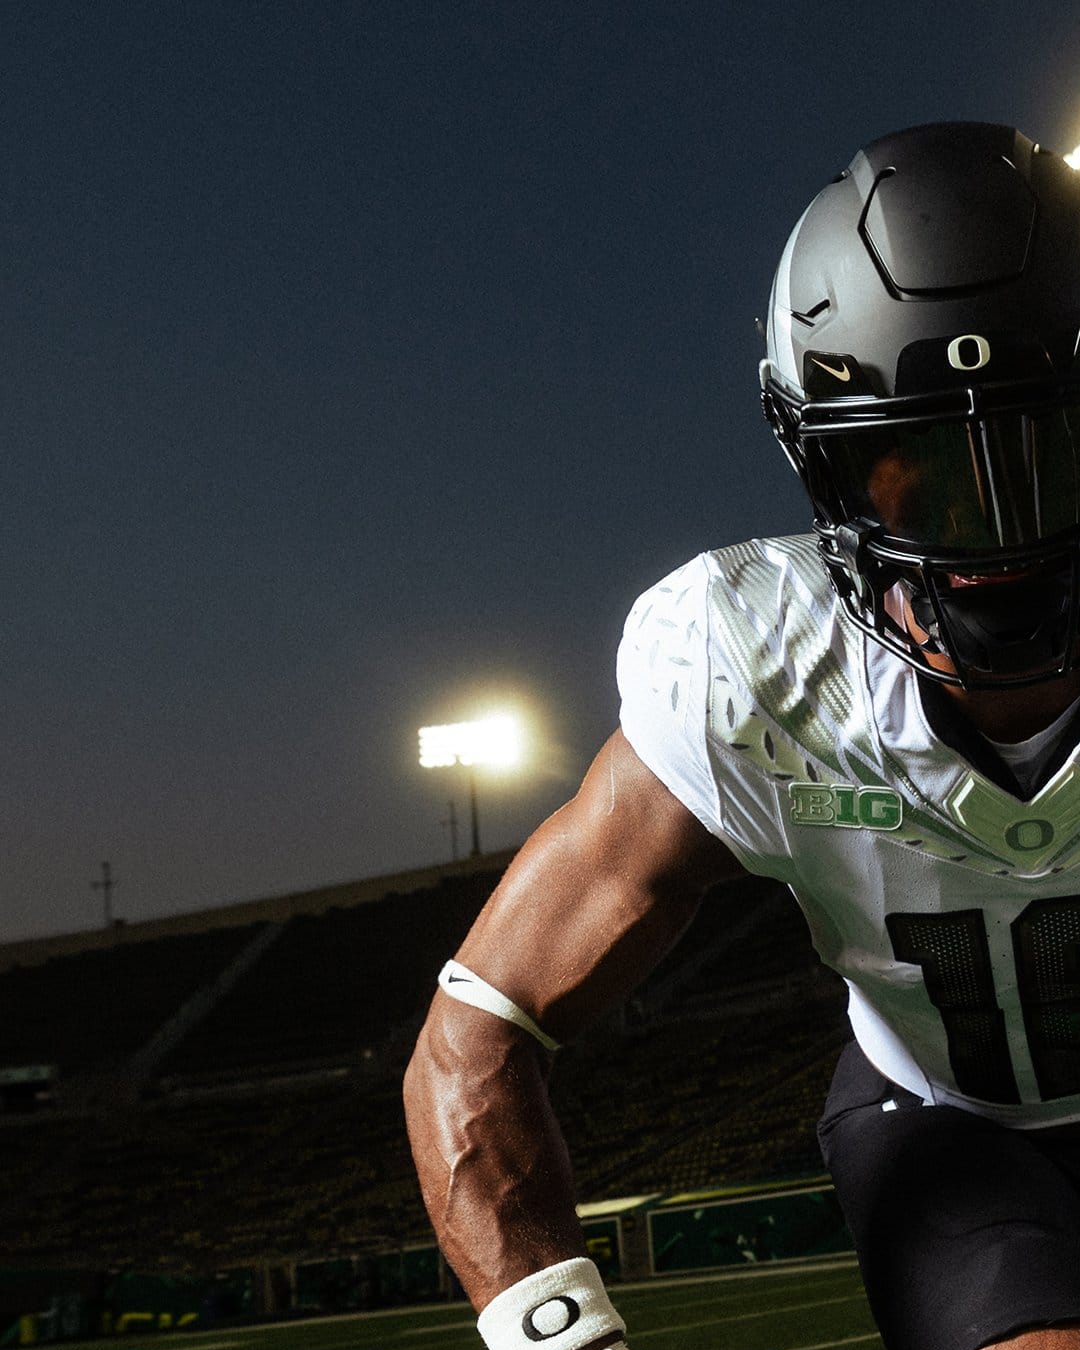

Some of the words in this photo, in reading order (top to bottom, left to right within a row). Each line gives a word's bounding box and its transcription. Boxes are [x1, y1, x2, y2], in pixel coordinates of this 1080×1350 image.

[947, 334, 991, 371] O
[1004, 819, 1054, 852] O
[521, 1295, 581, 1342] O
